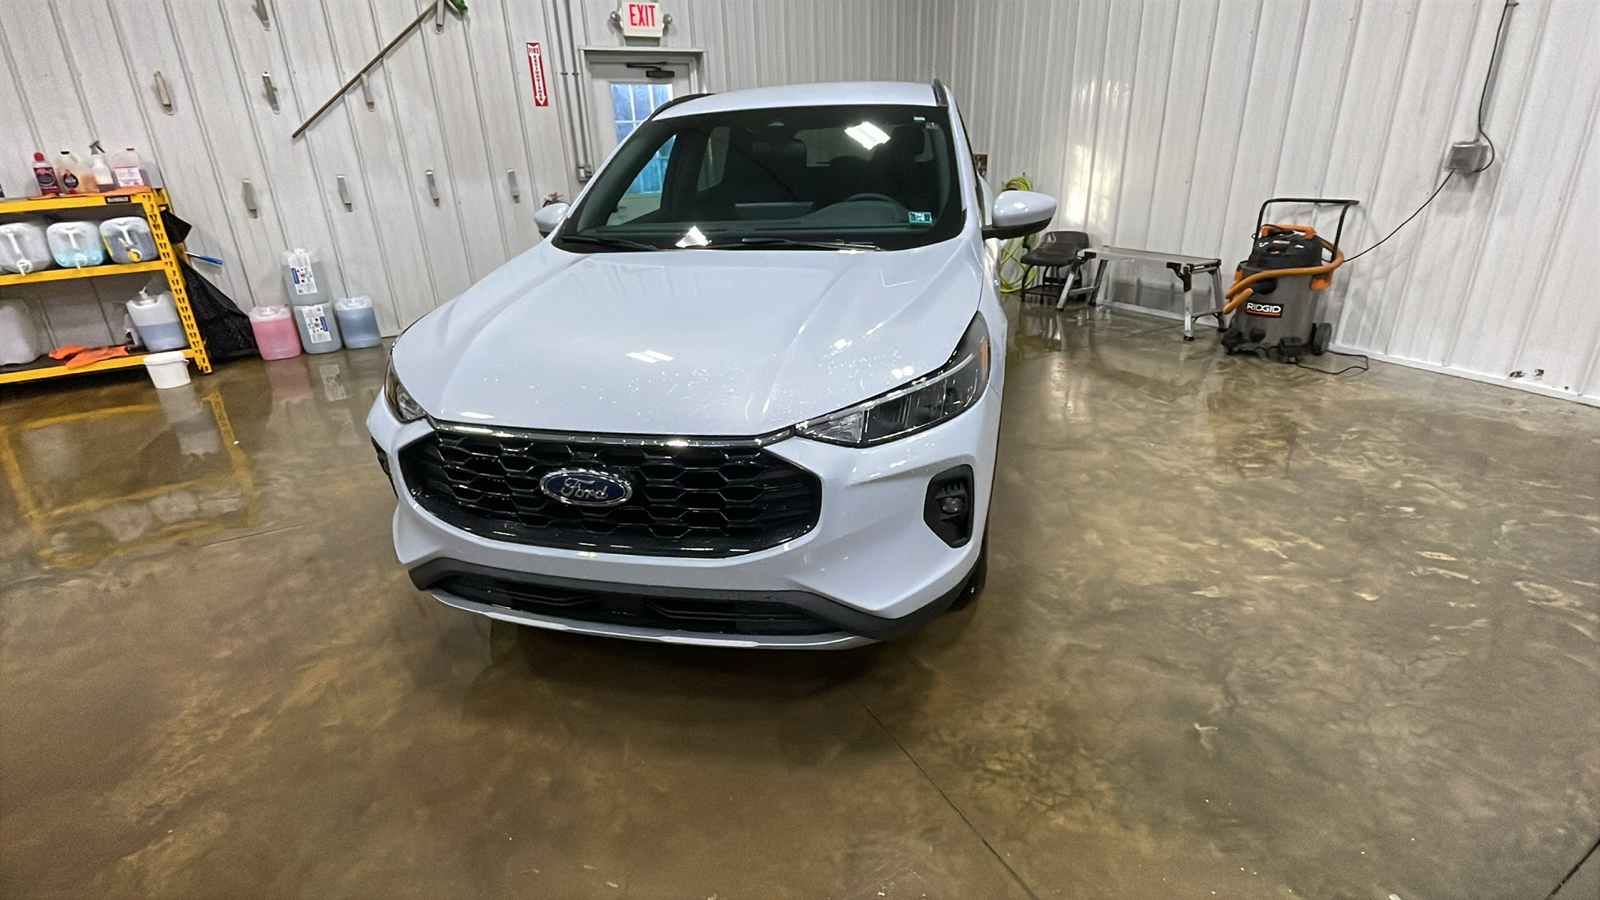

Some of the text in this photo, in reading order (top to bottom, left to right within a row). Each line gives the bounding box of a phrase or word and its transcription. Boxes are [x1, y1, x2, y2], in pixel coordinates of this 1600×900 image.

[629, 4, 656, 27] EXIT
[1246, 302, 1282, 313] RIDGID
[560, 477, 609, 499] Ford
